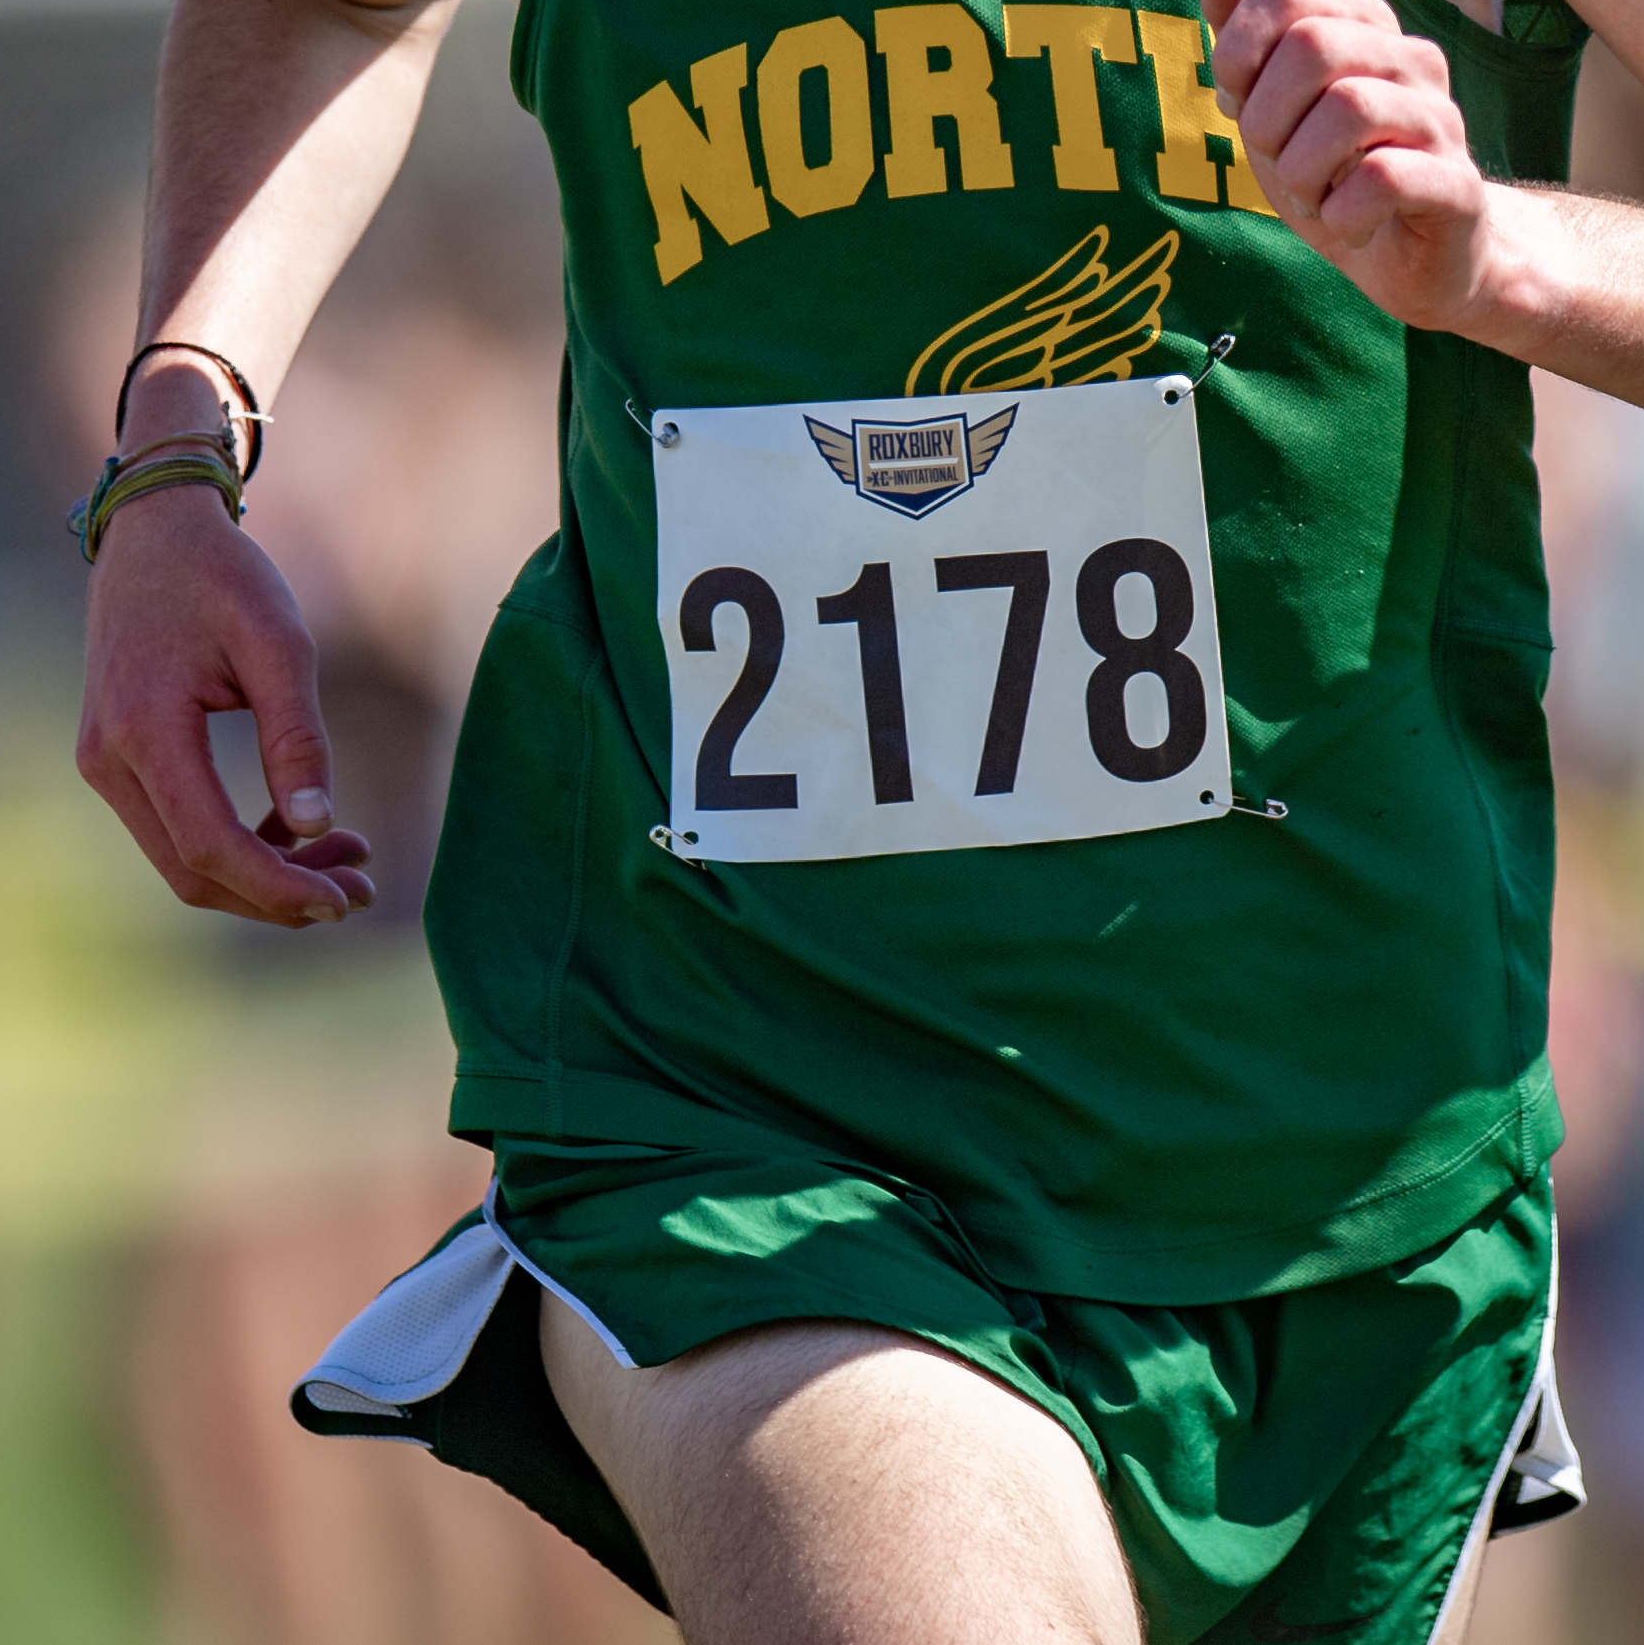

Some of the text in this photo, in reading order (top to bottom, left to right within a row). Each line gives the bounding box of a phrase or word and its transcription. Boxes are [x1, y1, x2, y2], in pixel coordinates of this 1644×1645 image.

[868, 429, 954, 460] ROXBURY
[893, 466, 959, 486] INVITATIONAL
[679, 537, 1208, 811] 2178
